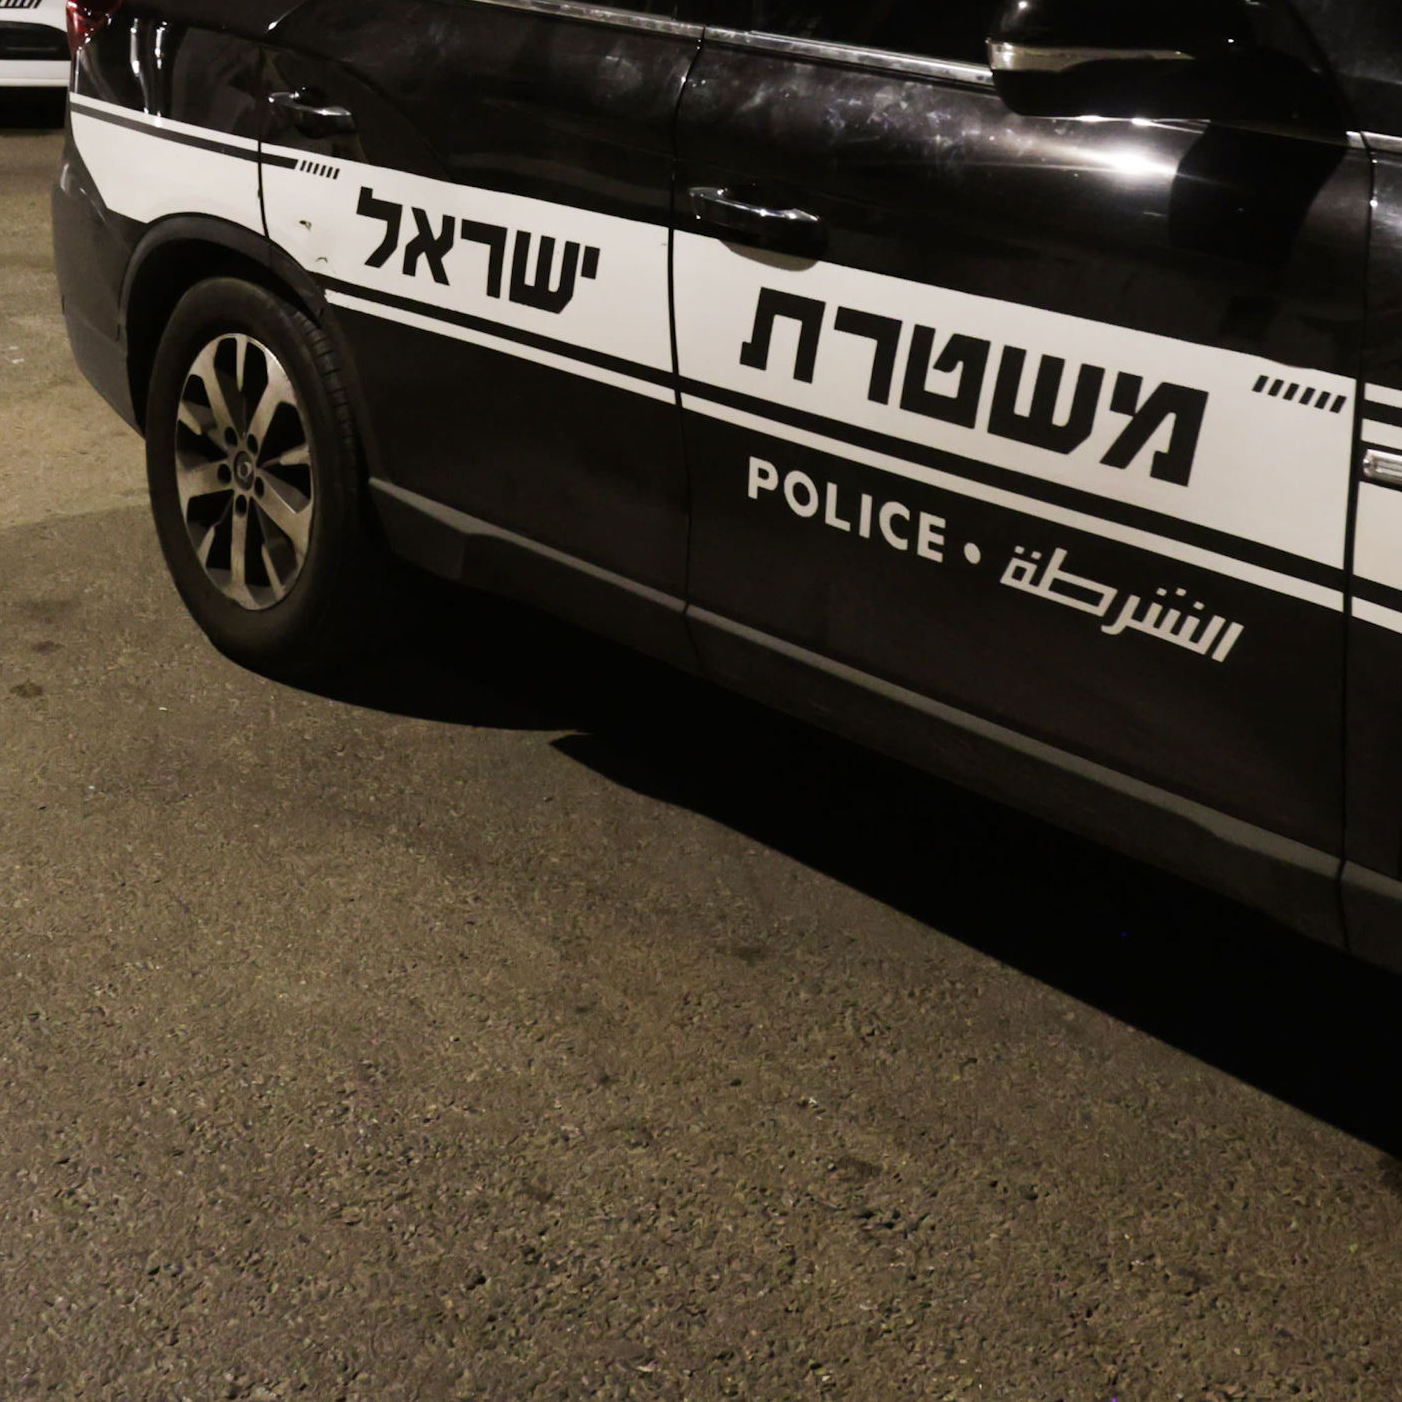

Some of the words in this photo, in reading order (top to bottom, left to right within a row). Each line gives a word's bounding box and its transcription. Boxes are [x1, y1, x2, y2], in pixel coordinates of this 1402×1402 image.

[356, 186, 601, 315] ישראל
[739, 286, 1209, 487] משטרת
[748, 456, 946, 563] POLICE
[999, 545, 1244, 663] الشرطة
